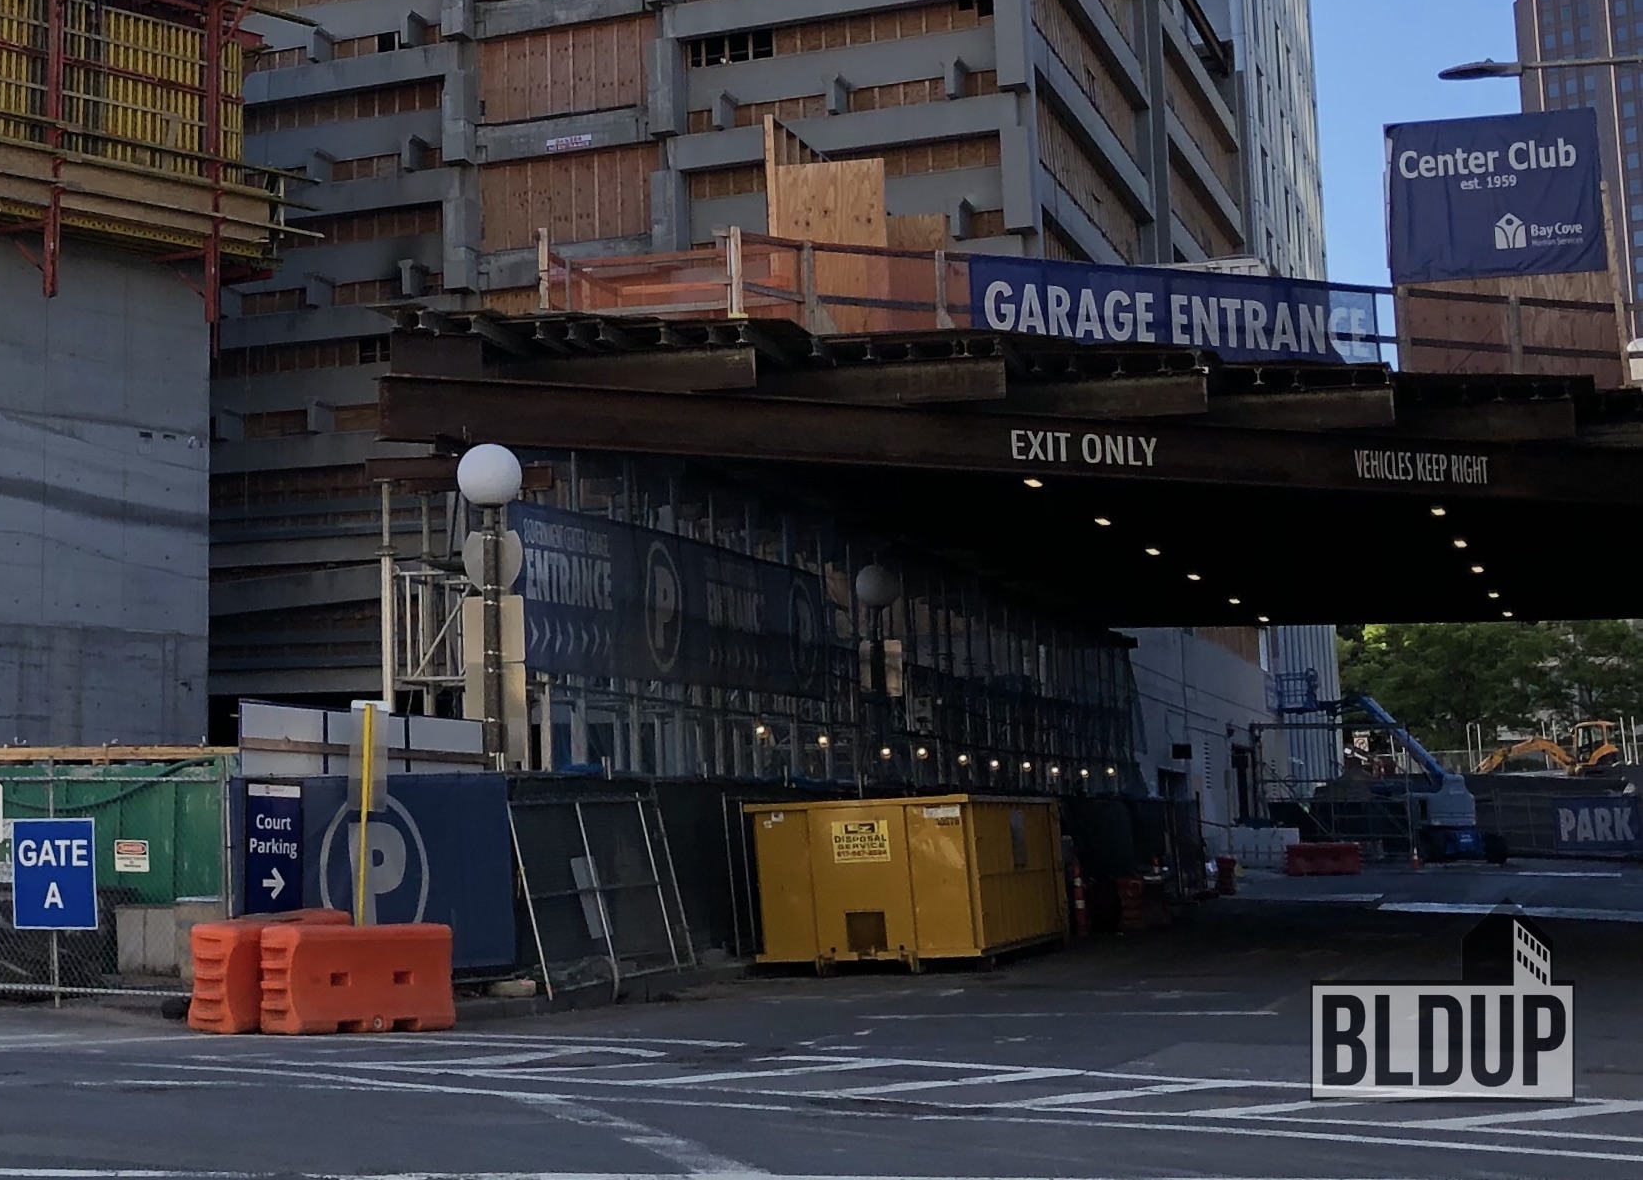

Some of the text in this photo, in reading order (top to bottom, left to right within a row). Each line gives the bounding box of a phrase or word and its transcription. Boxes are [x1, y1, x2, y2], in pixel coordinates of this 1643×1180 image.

[1398, 137, 1577, 179] Center Club
[1460, 174, 1517, 190] est. 1959
[1530, 222, 1583, 238] Bay Cove
[983, 280, 1368, 357] GARAGE ENTRANCE
[1010, 428, 1157, 467] EXIT ONLY
[1354, 449, 1489, 484] VEHICLES KEEP RIGHT
[524, 547, 613, 611] ENTRANCE
[255, 813, 292, 831] Court
[1559, 806, 1635, 842] PARK
[18, 839, 89, 867] GATE
[249, 838, 298, 859] Parking
[834, 834, 887, 844] DISPOSAL
[837, 842, 885, 850] SERVICE
[347, 821, 407, 926] P
[43, 881, 65, 909] A
